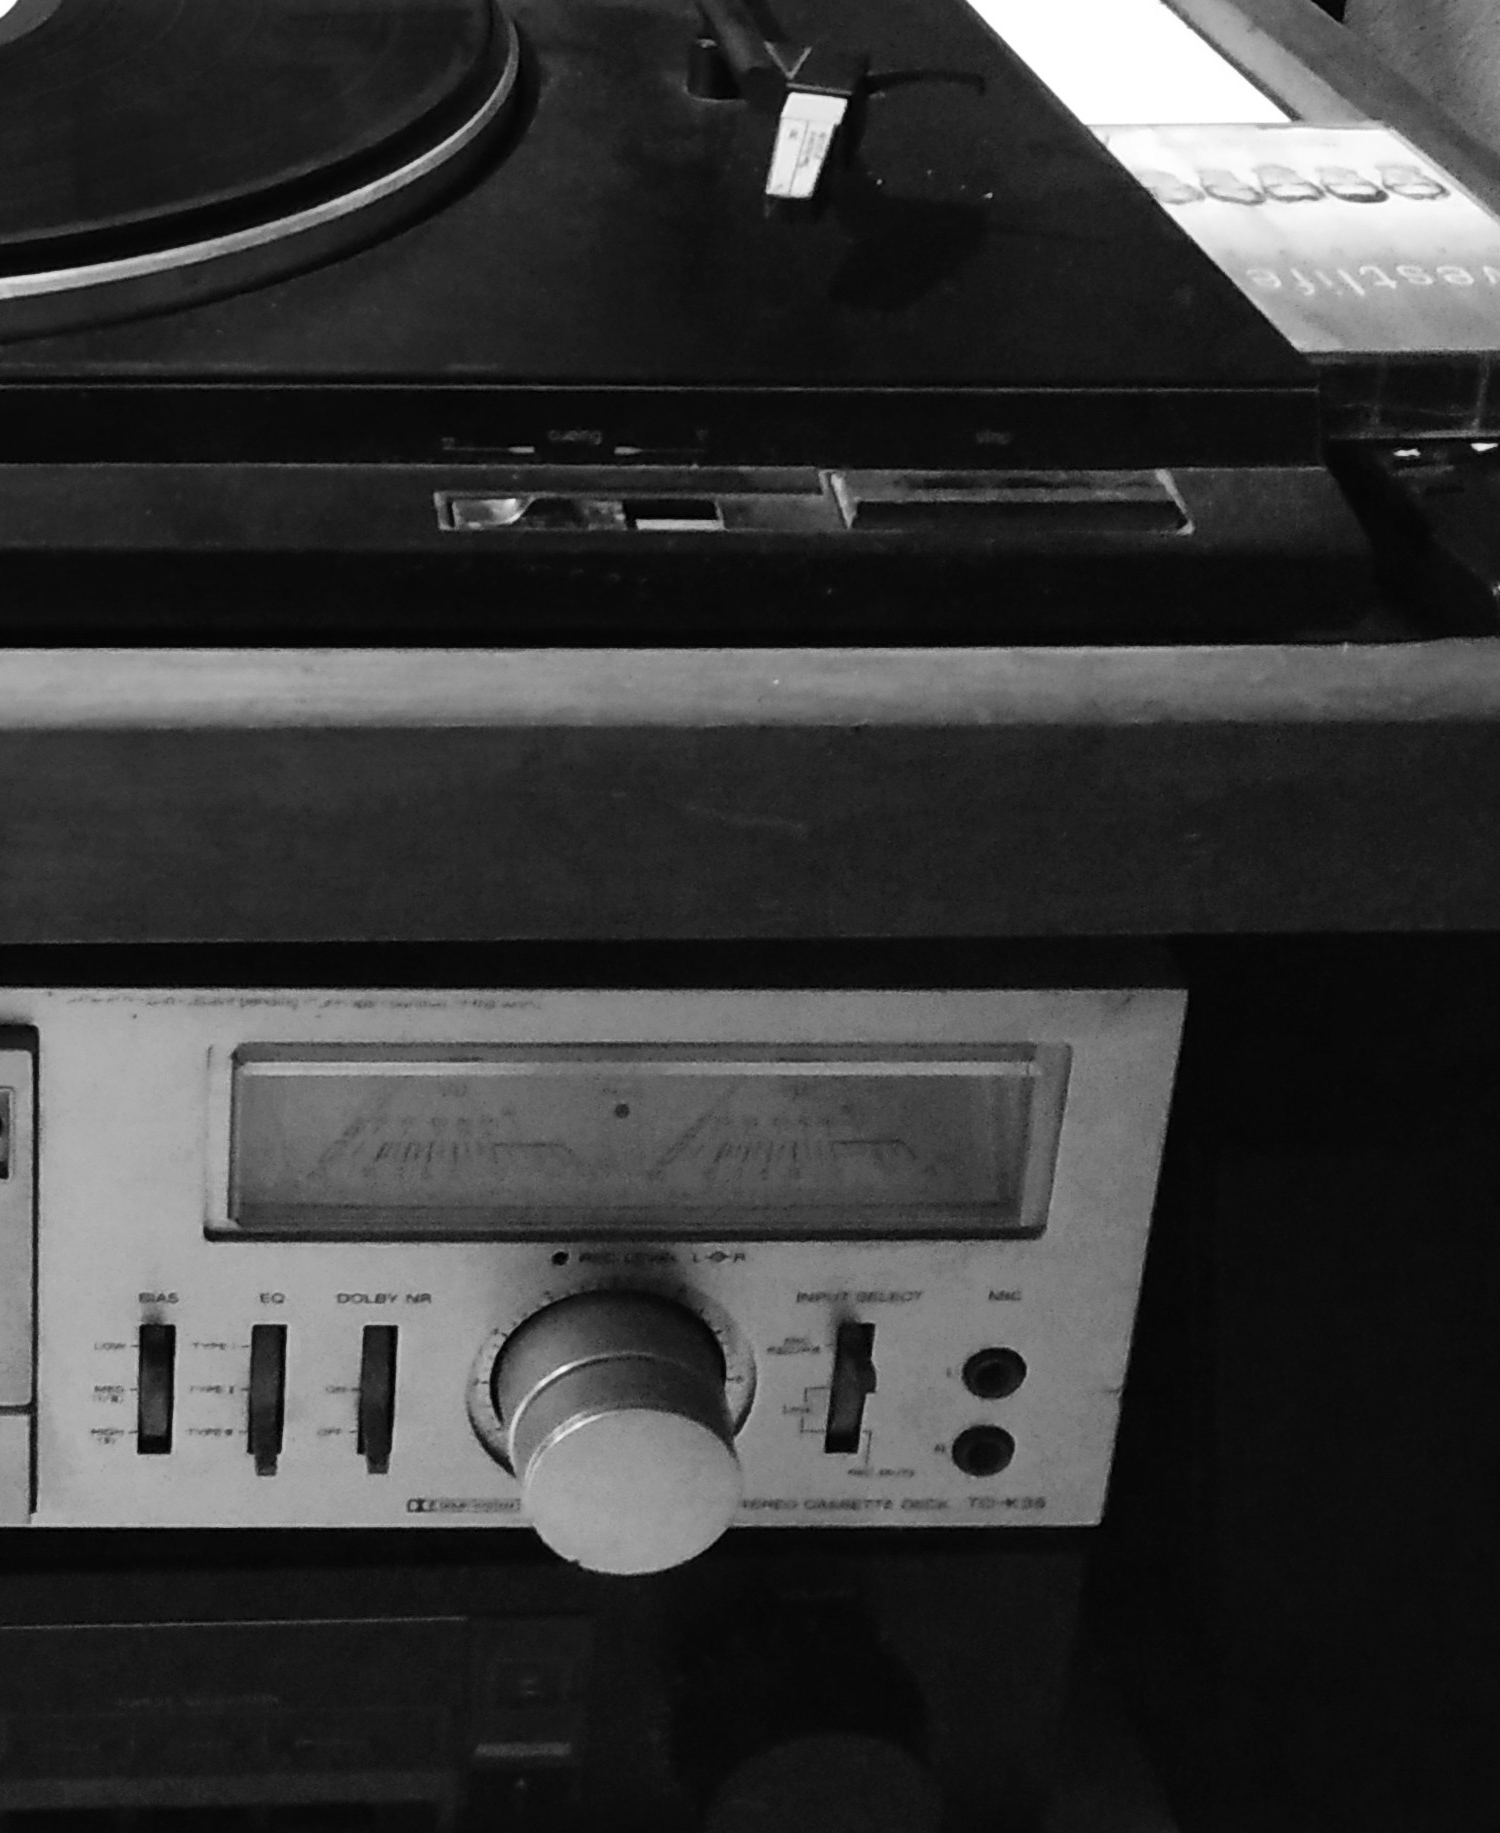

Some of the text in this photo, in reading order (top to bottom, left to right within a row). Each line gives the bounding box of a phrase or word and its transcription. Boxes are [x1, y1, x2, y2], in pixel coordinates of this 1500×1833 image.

[138, 1292, 180, 1304] BIAS
[259, 1292, 286, 1305] EQ
[336, 1292, 398, 1305] DOLBY
[741, 1498, 798, 1510] TEREO
